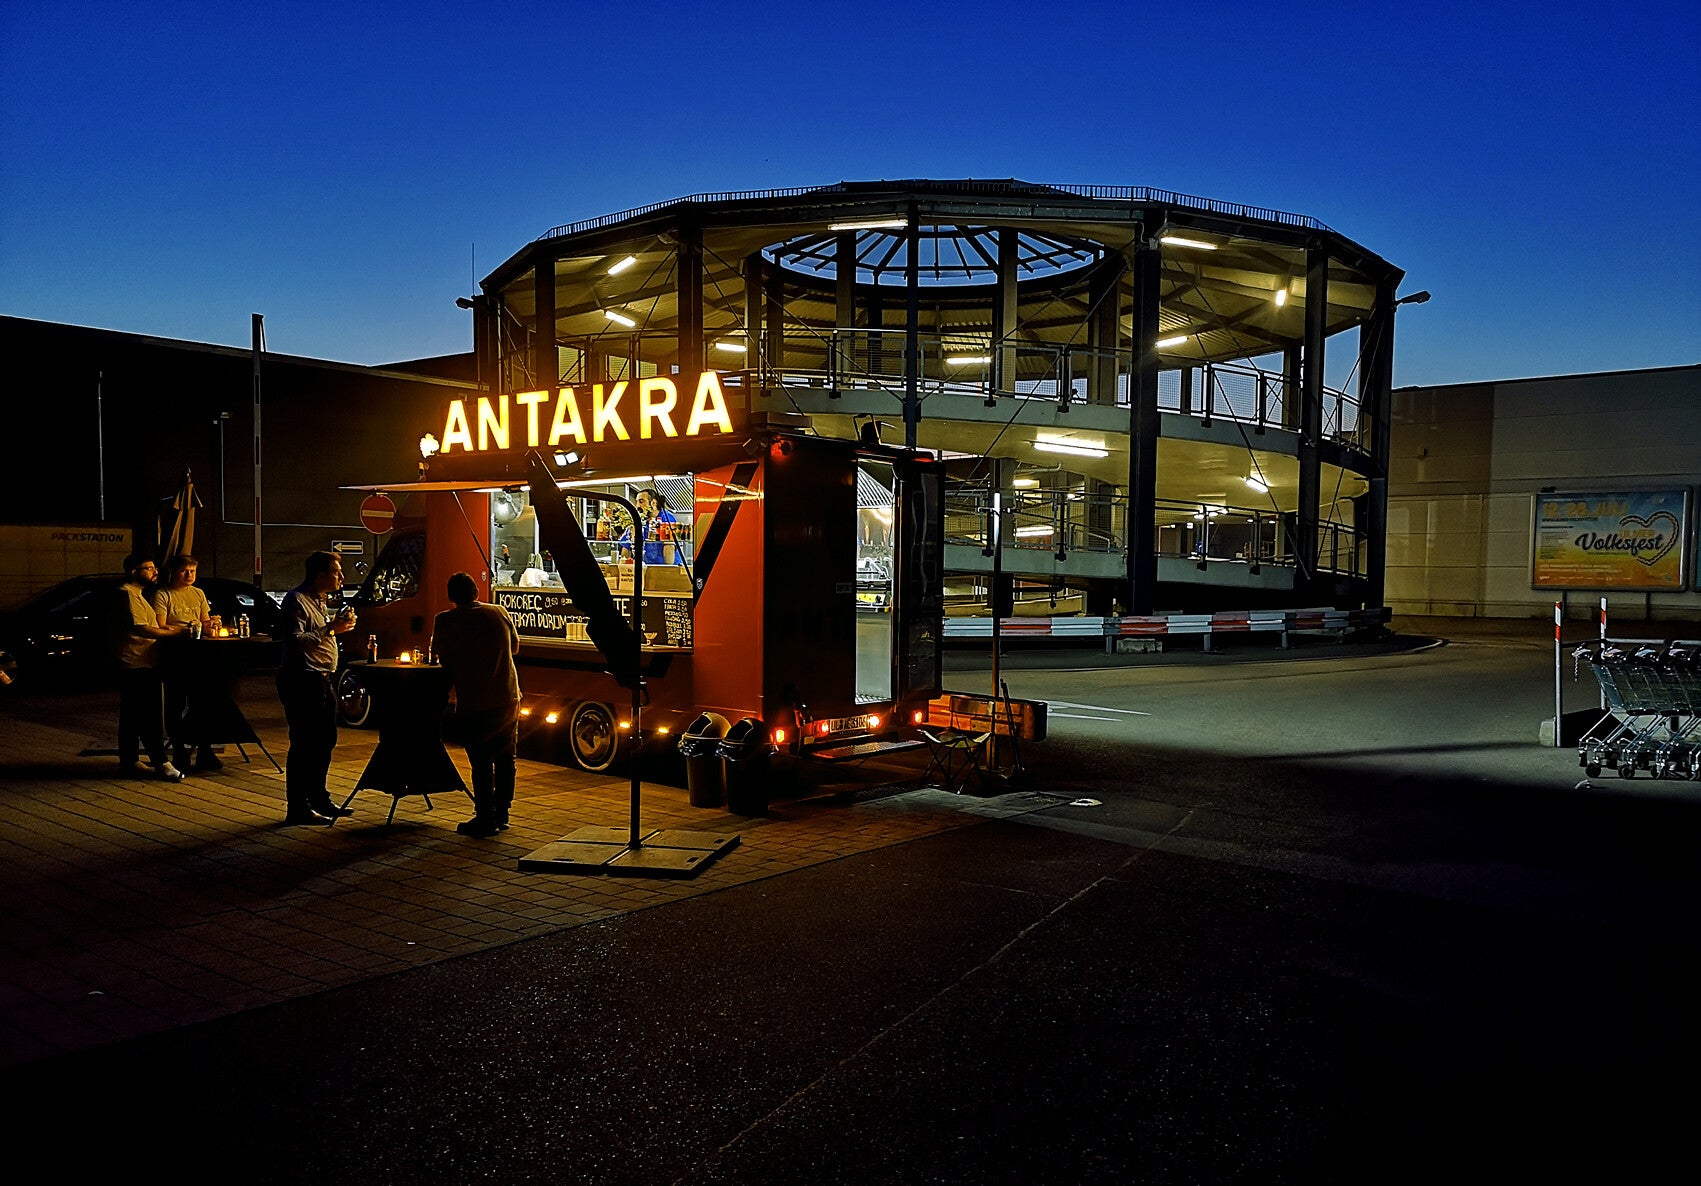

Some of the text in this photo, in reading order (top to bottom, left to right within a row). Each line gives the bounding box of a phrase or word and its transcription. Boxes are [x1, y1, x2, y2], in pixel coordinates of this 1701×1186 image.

[440, 371, 733, 453] ANTAKRA
[51, 533, 123, 542] PACKSTATION
[1575, 532, 1663, 556] Volksfest
